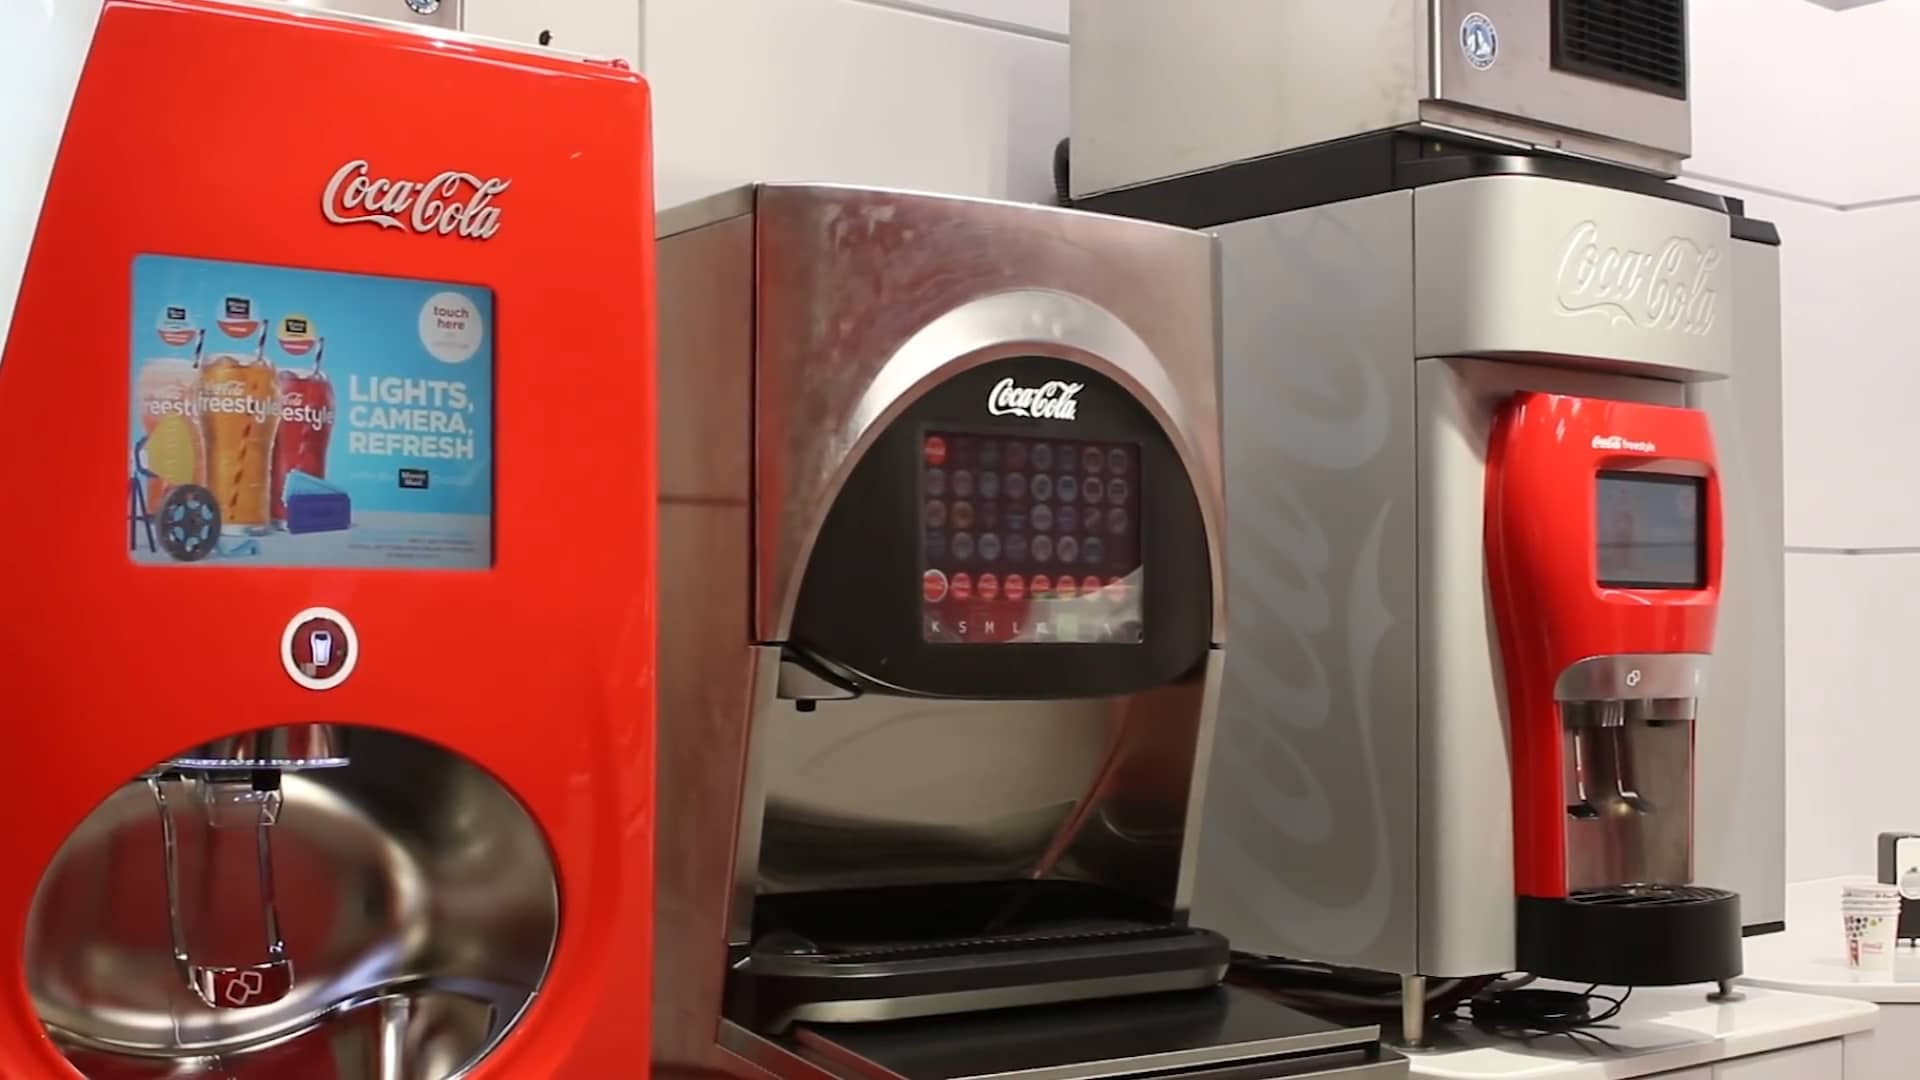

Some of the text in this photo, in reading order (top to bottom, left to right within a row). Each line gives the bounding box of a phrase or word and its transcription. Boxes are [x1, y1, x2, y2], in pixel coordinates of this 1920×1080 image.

[322, 160, 512, 239] Coca-Cola
[1556, 219, 1721, 336] Coca-Cola
[433, 306, 470, 319] touch
[437, 318, 465, 330] here
[349, 374, 474, 412] LIGHTS,
[987, 377, 1085, 420] Coca-Cola
[349, 405, 474, 436] CAMERA,
[349, 431, 475, 459] REFRESH
